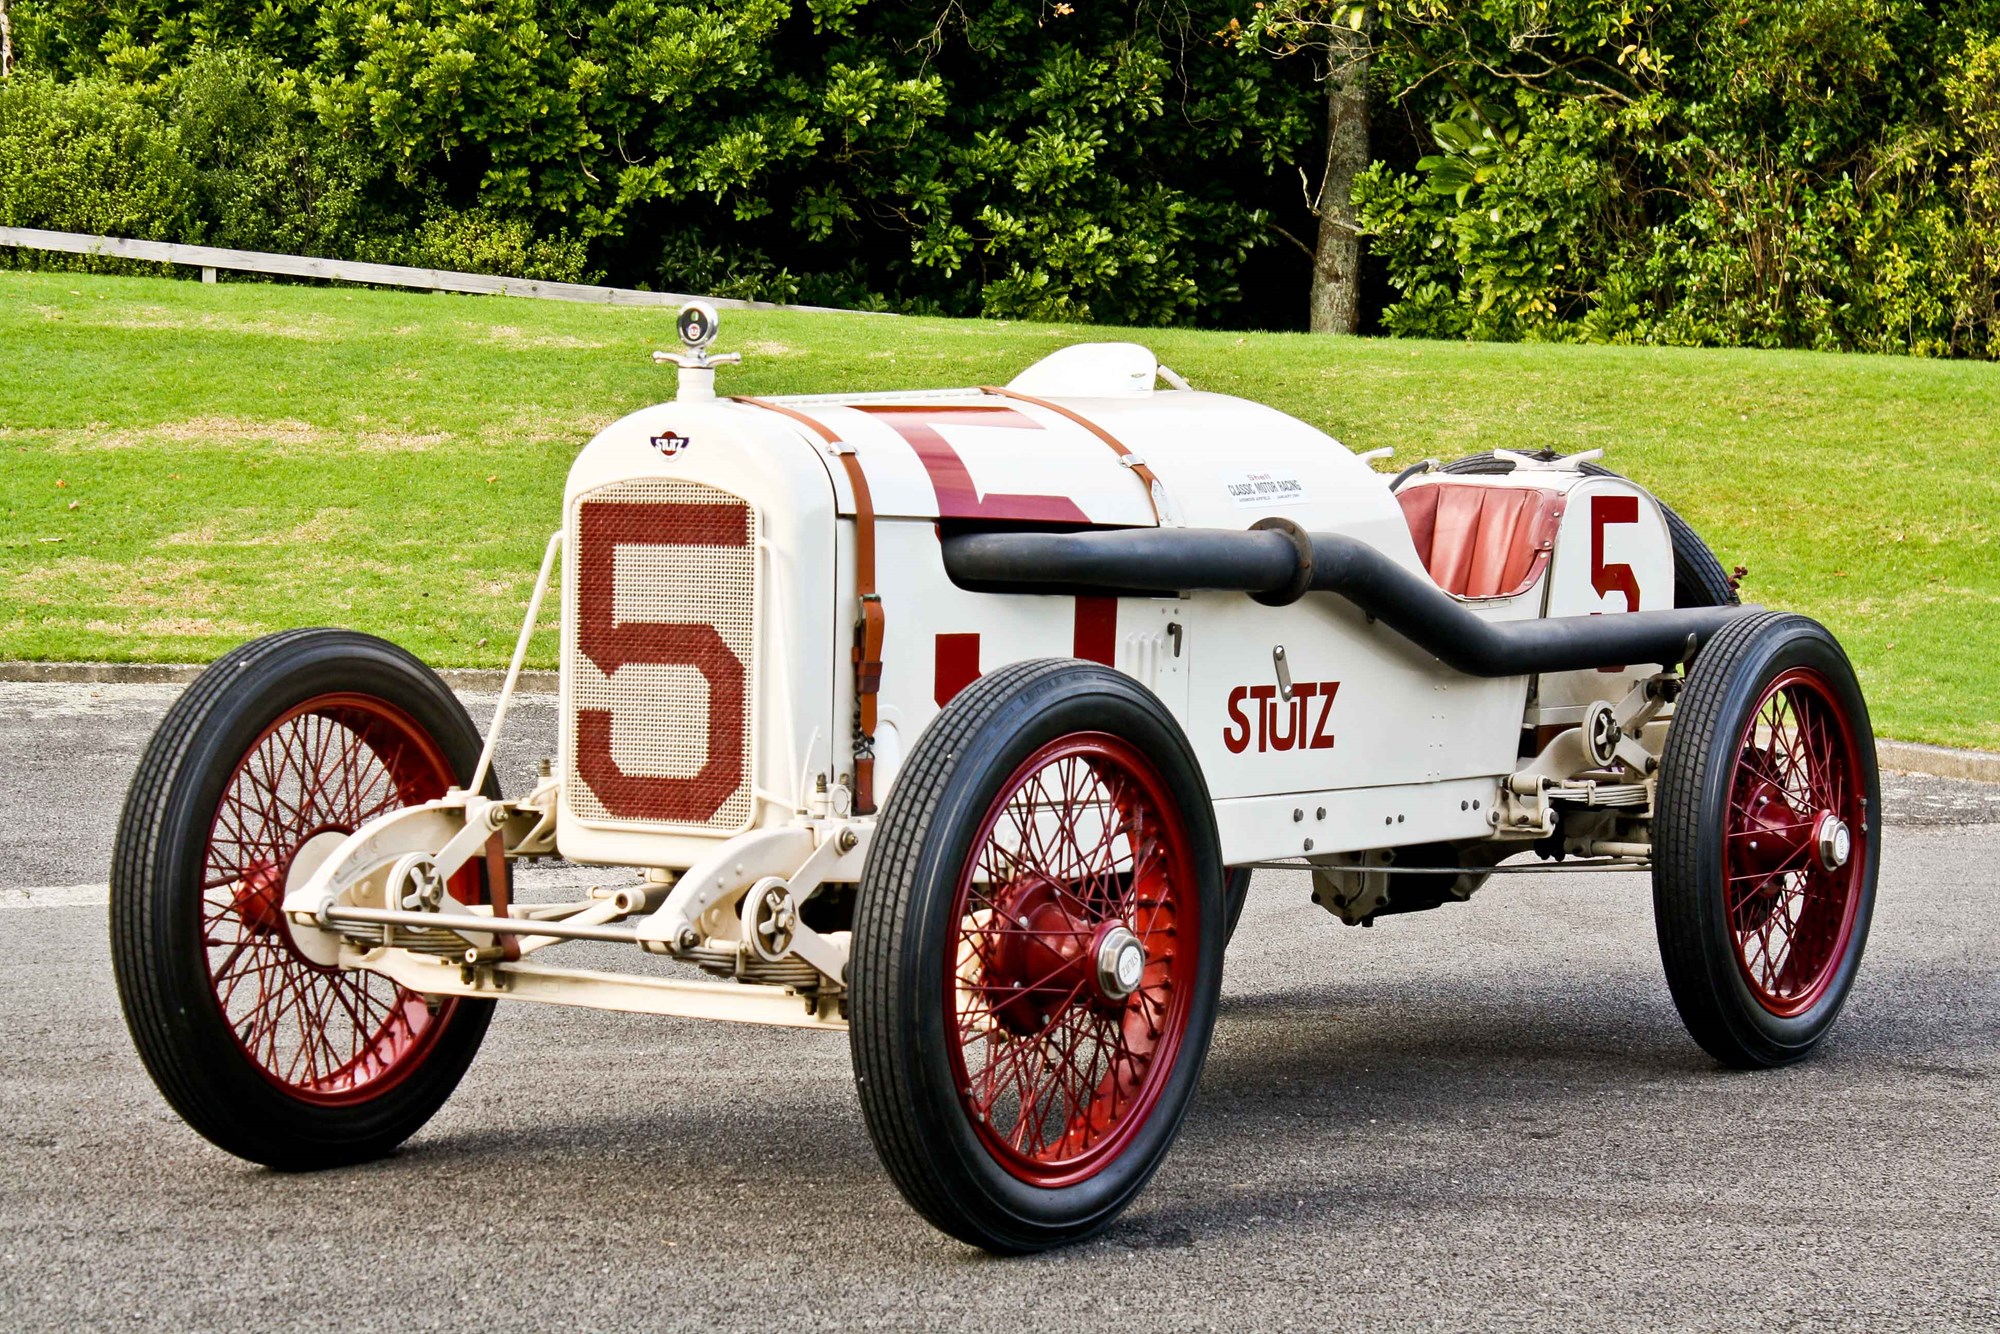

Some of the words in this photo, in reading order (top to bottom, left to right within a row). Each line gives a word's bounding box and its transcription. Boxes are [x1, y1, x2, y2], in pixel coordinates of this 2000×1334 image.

[655, 438, 684, 452] STUTZ
[1228, 483, 1256, 496] CLASSIC
[1254, 481, 1278, 494] MOTOR
[1277, 479, 1302, 491] RACING
[1246, 473, 1271, 481] Shell
[1590, 496, 1640, 673] 5
[577, 502, 747, 822] 5
[1223, 681, 1341, 754] STUTZ
